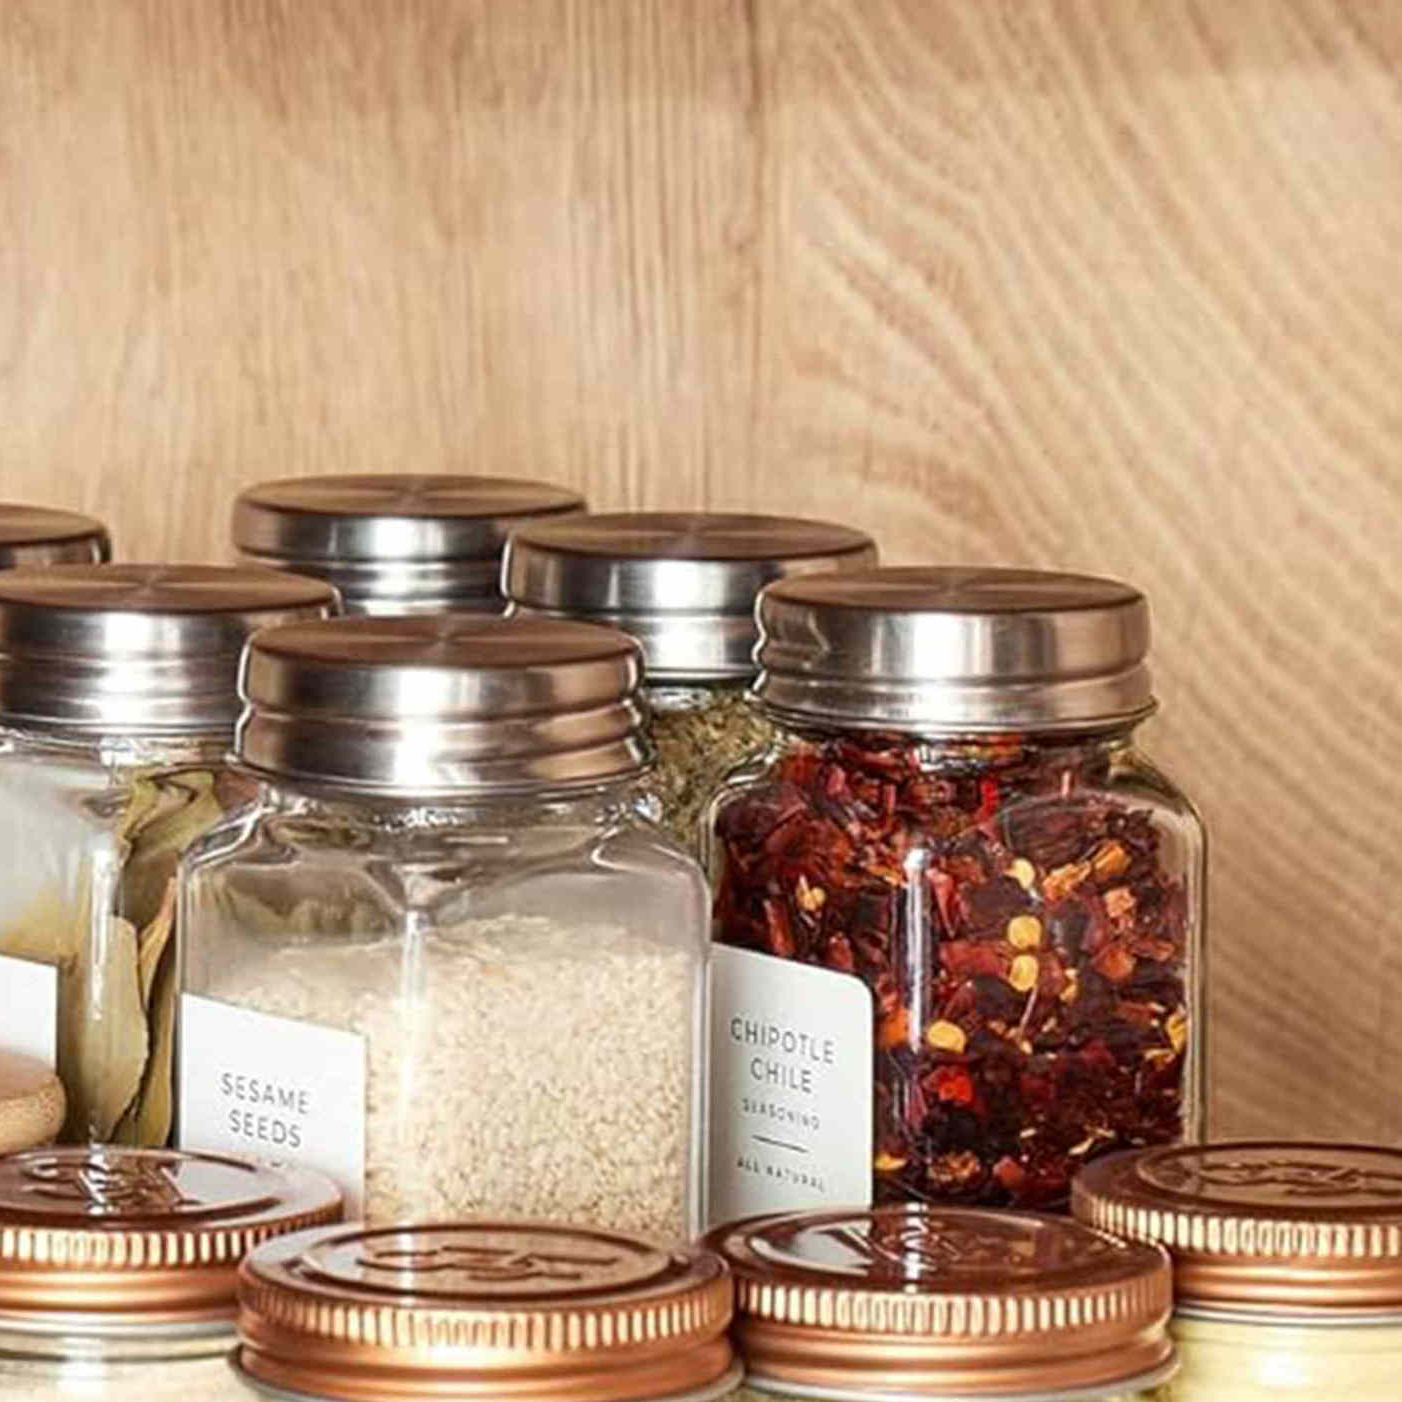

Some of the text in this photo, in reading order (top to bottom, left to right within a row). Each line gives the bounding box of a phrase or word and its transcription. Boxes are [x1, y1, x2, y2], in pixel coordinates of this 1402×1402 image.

[730, 1017, 834, 1065] CHIPOTLE
[220, 1073, 309, 1115] SESAME
[750, 1057, 812, 1094] CHILE
[228, 1109, 302, 1148] SEEDS
